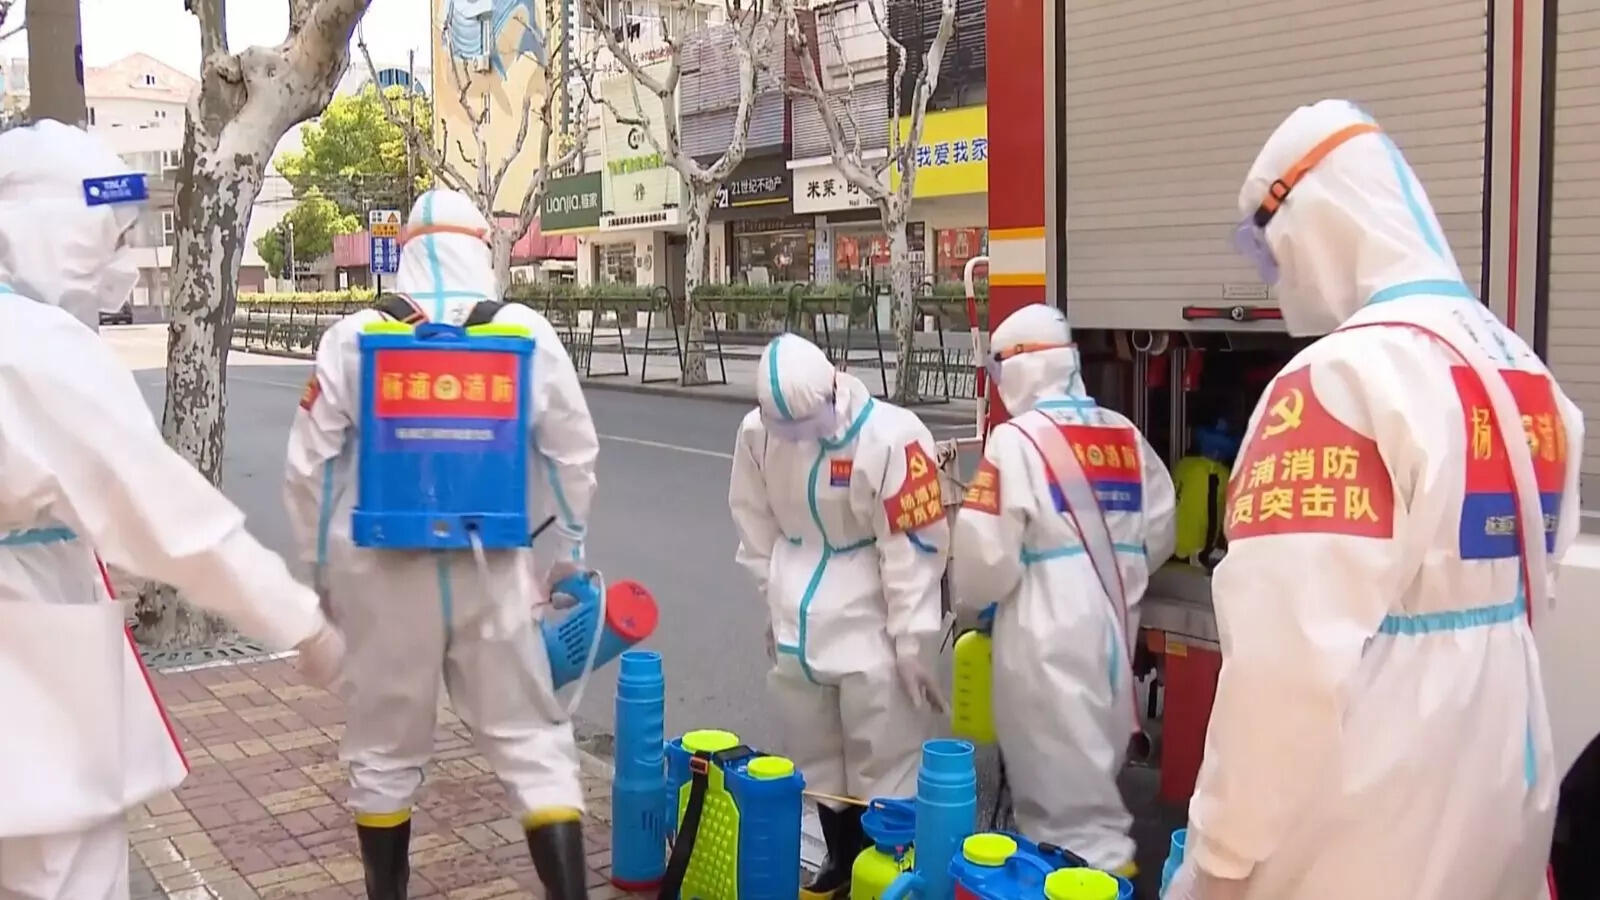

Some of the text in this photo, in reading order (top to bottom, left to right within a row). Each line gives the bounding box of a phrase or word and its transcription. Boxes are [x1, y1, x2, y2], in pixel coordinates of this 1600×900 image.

[917, 138, 988, 167] 我爱我家
[731, 176, 783, 195] 21世纪不动产
